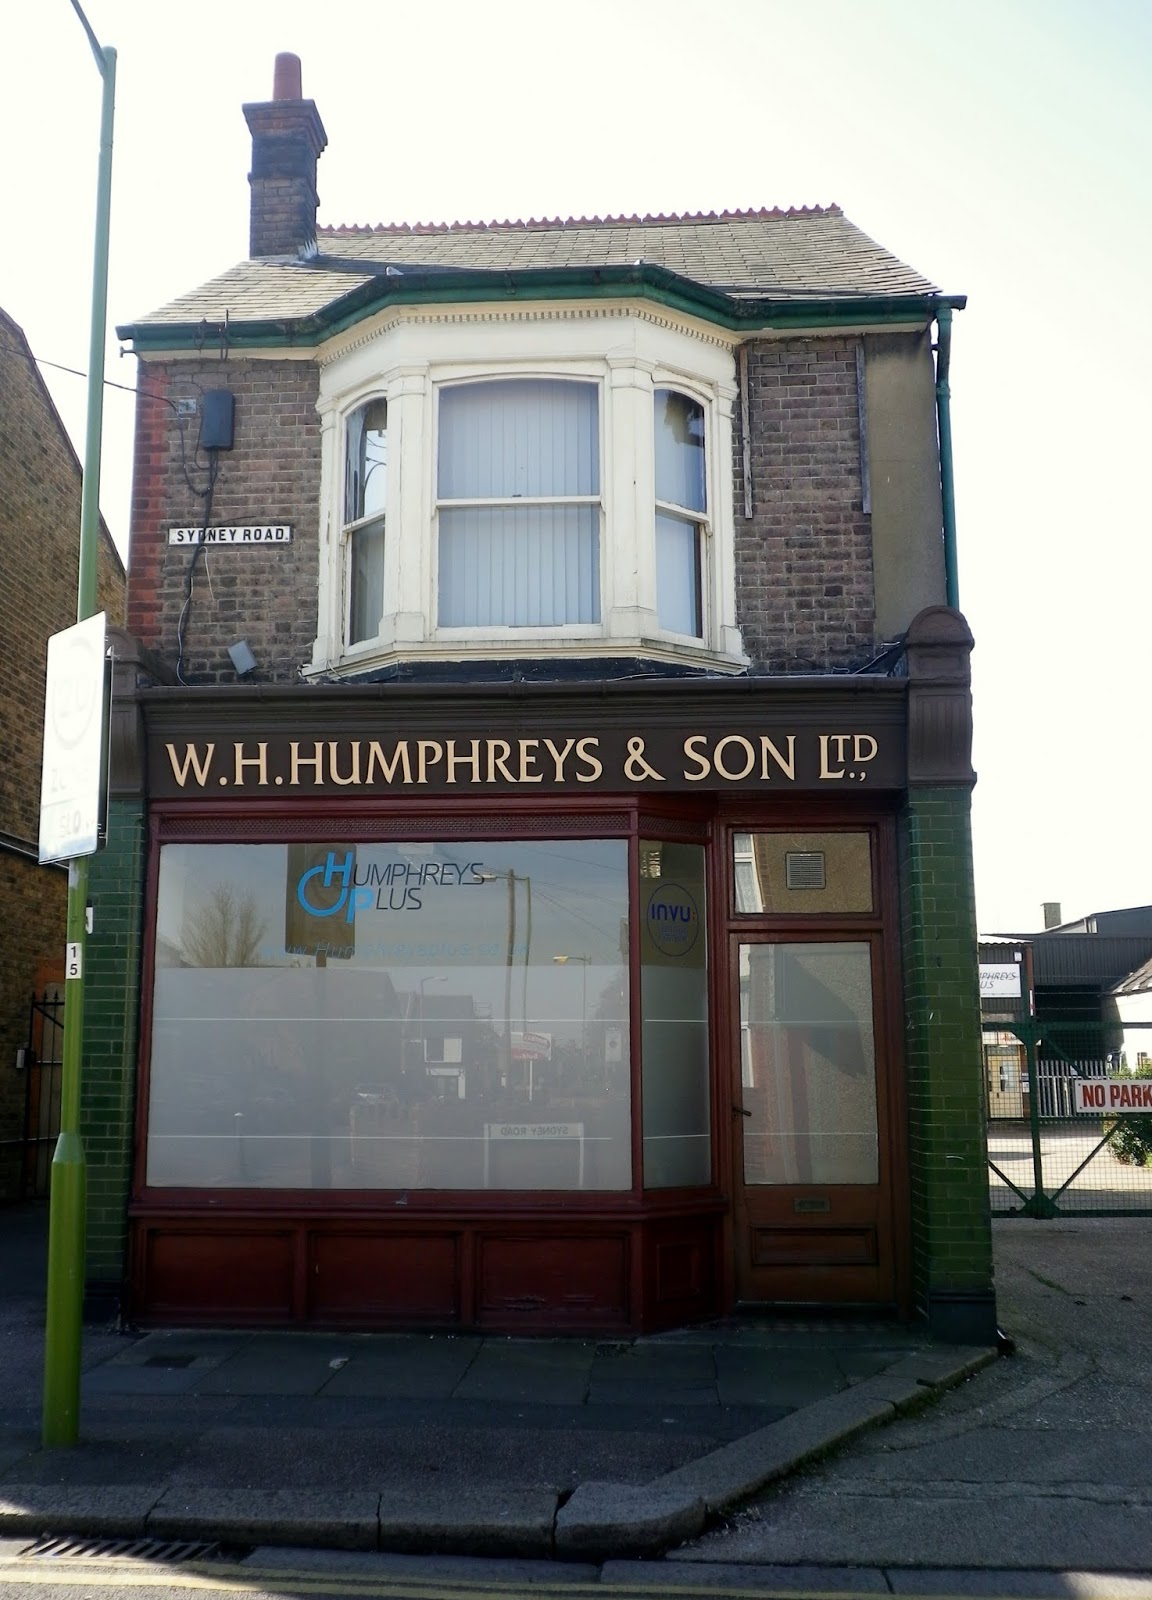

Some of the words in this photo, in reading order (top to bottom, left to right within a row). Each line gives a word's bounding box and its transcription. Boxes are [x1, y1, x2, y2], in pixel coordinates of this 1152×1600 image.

[243, 528, 284, 541] ROAD
[623, 736, 667, 782] &
[683, 735, 796, 781] SON
[1082, 1084, 1106, 1107] NO
